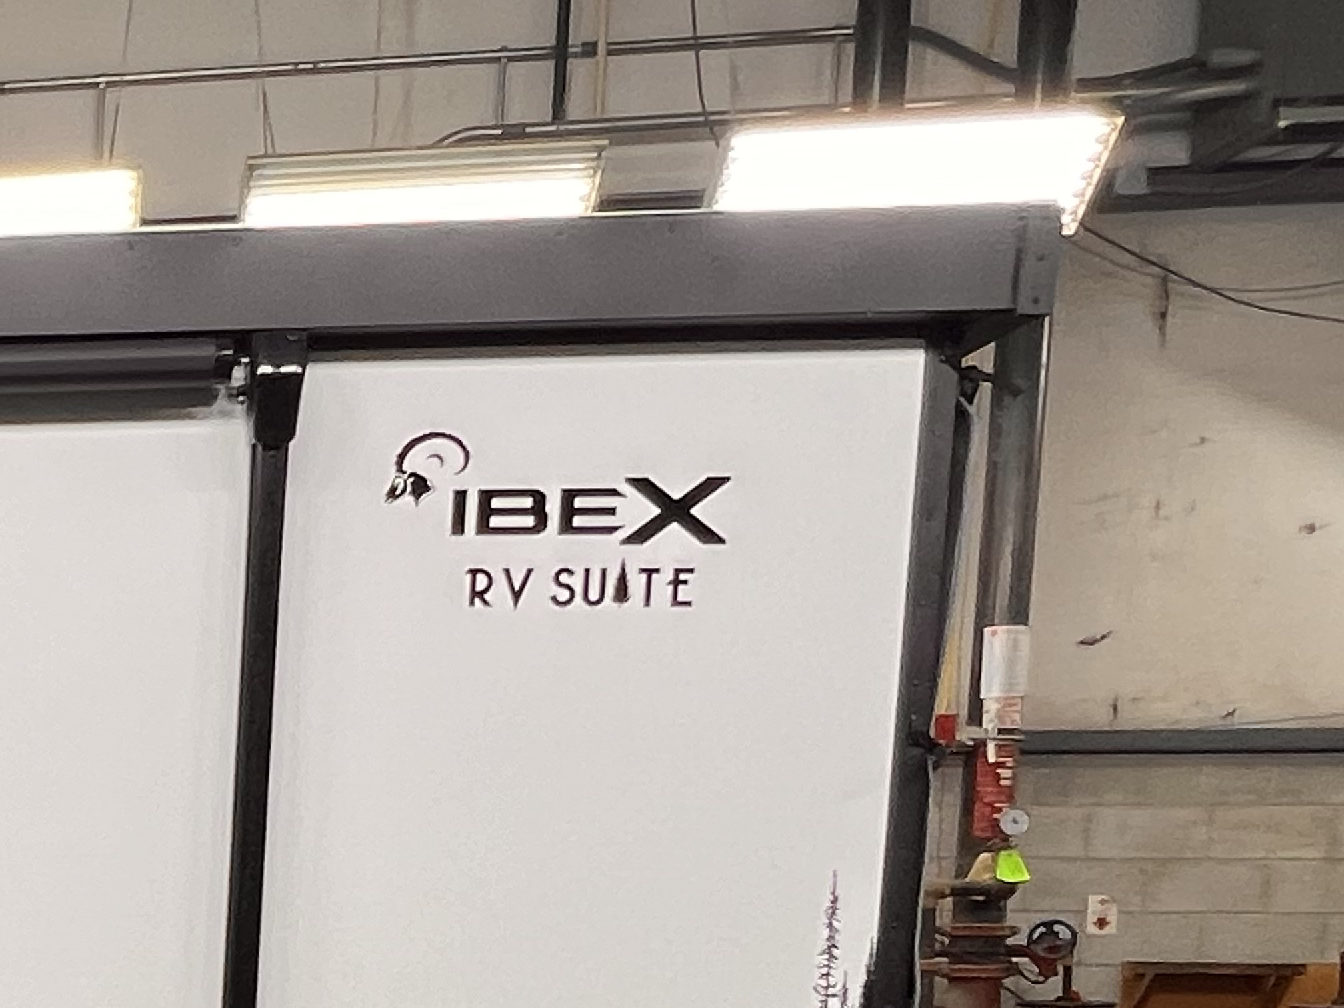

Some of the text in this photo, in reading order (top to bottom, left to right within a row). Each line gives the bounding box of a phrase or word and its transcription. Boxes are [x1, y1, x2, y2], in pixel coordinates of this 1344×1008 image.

[451, 476, 731, 545] IBEX
[466, 559, 696, 610] RV SUITE
